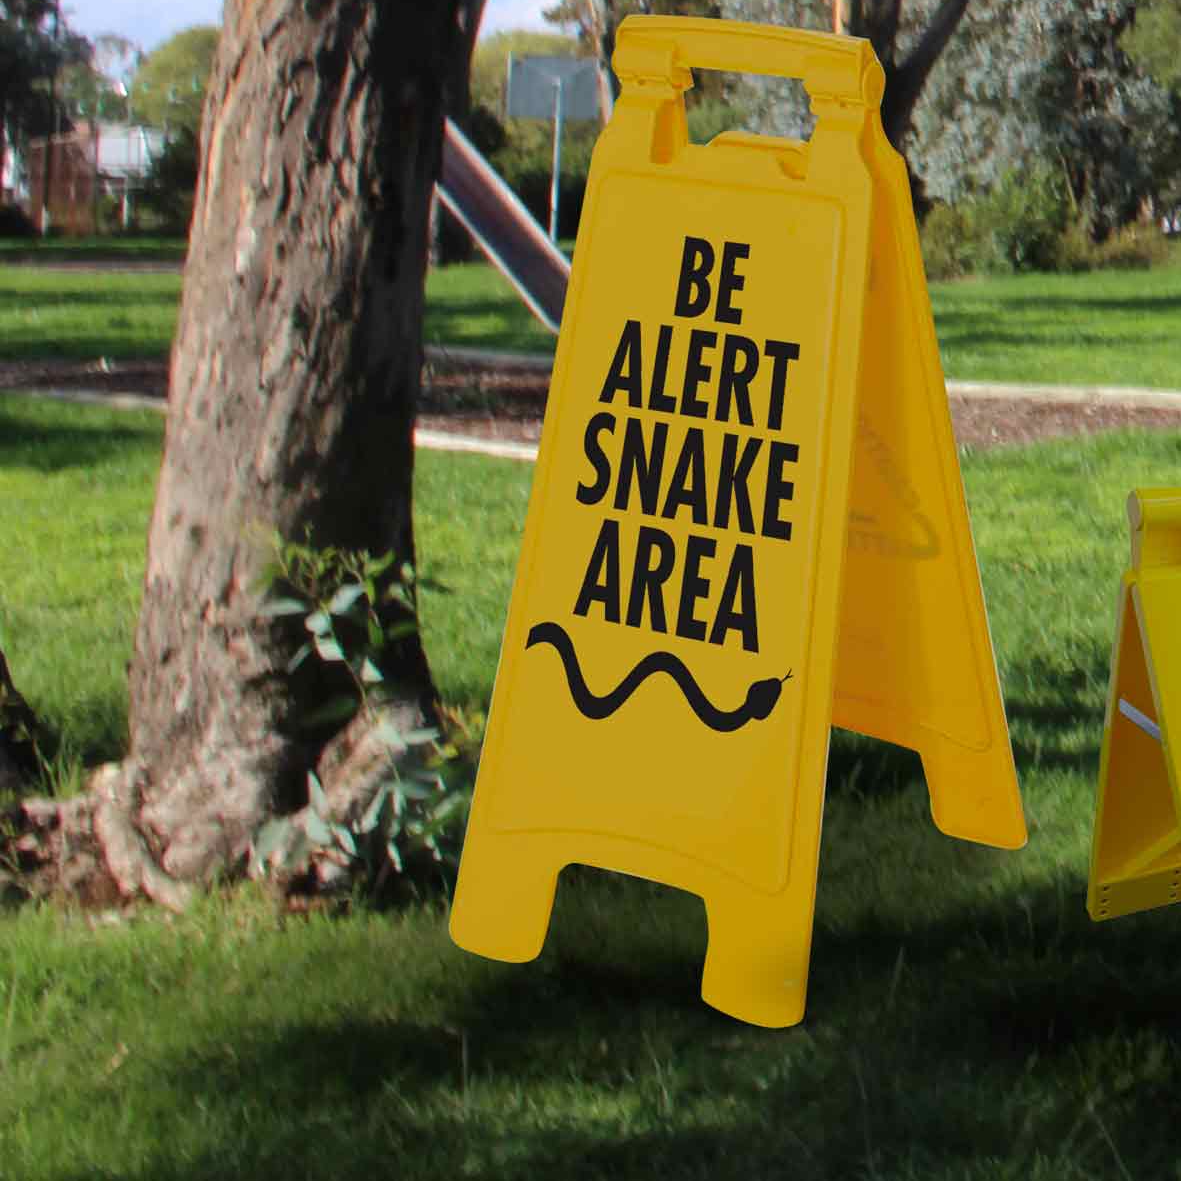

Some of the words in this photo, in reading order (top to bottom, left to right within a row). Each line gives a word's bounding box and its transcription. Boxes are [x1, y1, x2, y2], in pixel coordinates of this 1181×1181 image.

[675, 237, 750, 324] BE
[599, 320, 800, 430] ALERT
[576, 413, 799, 540] SNAKE
[574, 520, 759, 652] AREA
